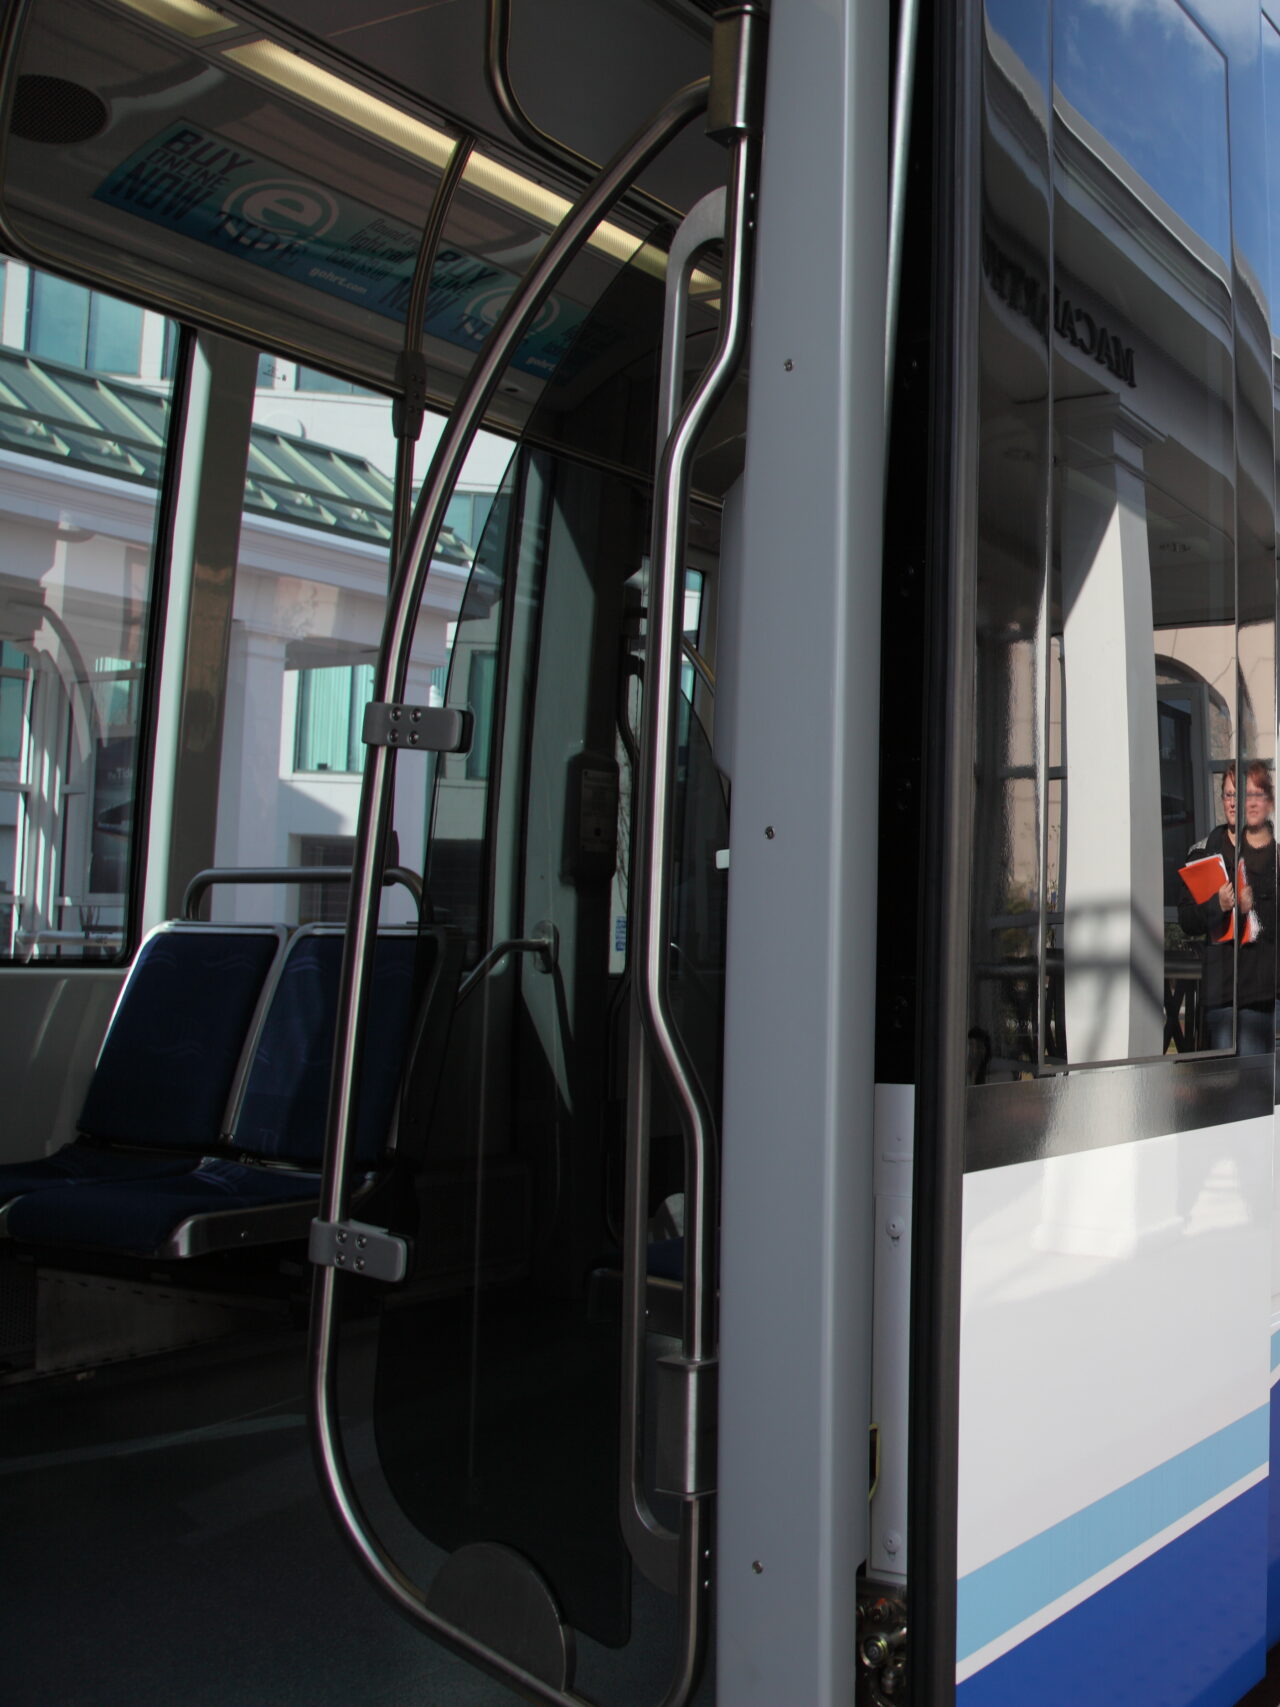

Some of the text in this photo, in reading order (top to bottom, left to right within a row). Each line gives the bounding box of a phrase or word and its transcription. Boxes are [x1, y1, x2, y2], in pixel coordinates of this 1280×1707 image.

[146, 148, 230, 193] ONLINE
[163, 128, 254, 175] BUY
[110, 162, 218, 221] NOW
